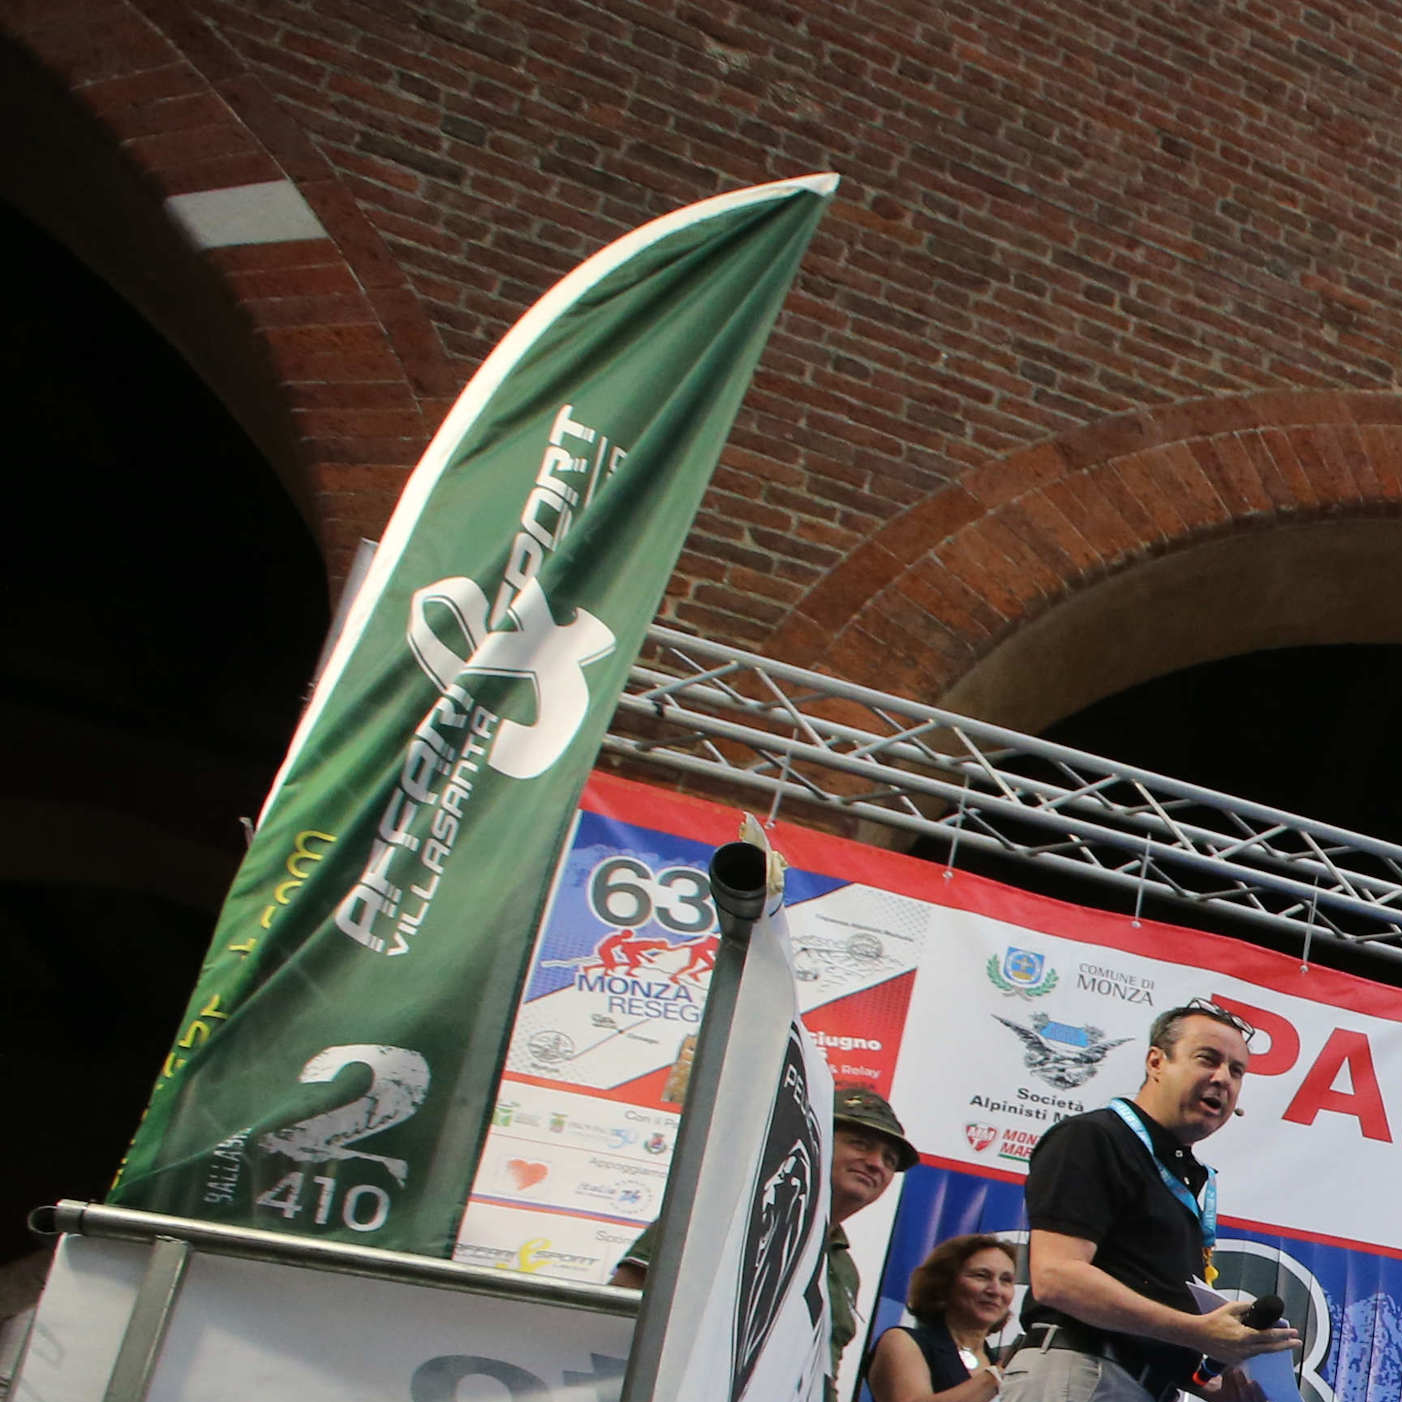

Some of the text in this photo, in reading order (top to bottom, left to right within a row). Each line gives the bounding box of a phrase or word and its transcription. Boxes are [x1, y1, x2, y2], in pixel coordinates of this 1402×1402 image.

[489, 404, 597, 632] PORT
[386, 704, 500, 957] VILLASANTA
[590, 856, 714, 935] 63
[577, 972, 694, 1004] MONZA
[1076, 973, 1155, 1007] MONZA
[1079, 962, 1155, 990] COMUNE DI
[607, 996, 700, 1024] RESEG
[969, 1094, 1048, 1122] Alpinisti
[1016, 1086, 1085, 1114] Società
[256, 1171, 391, 1233] 410
